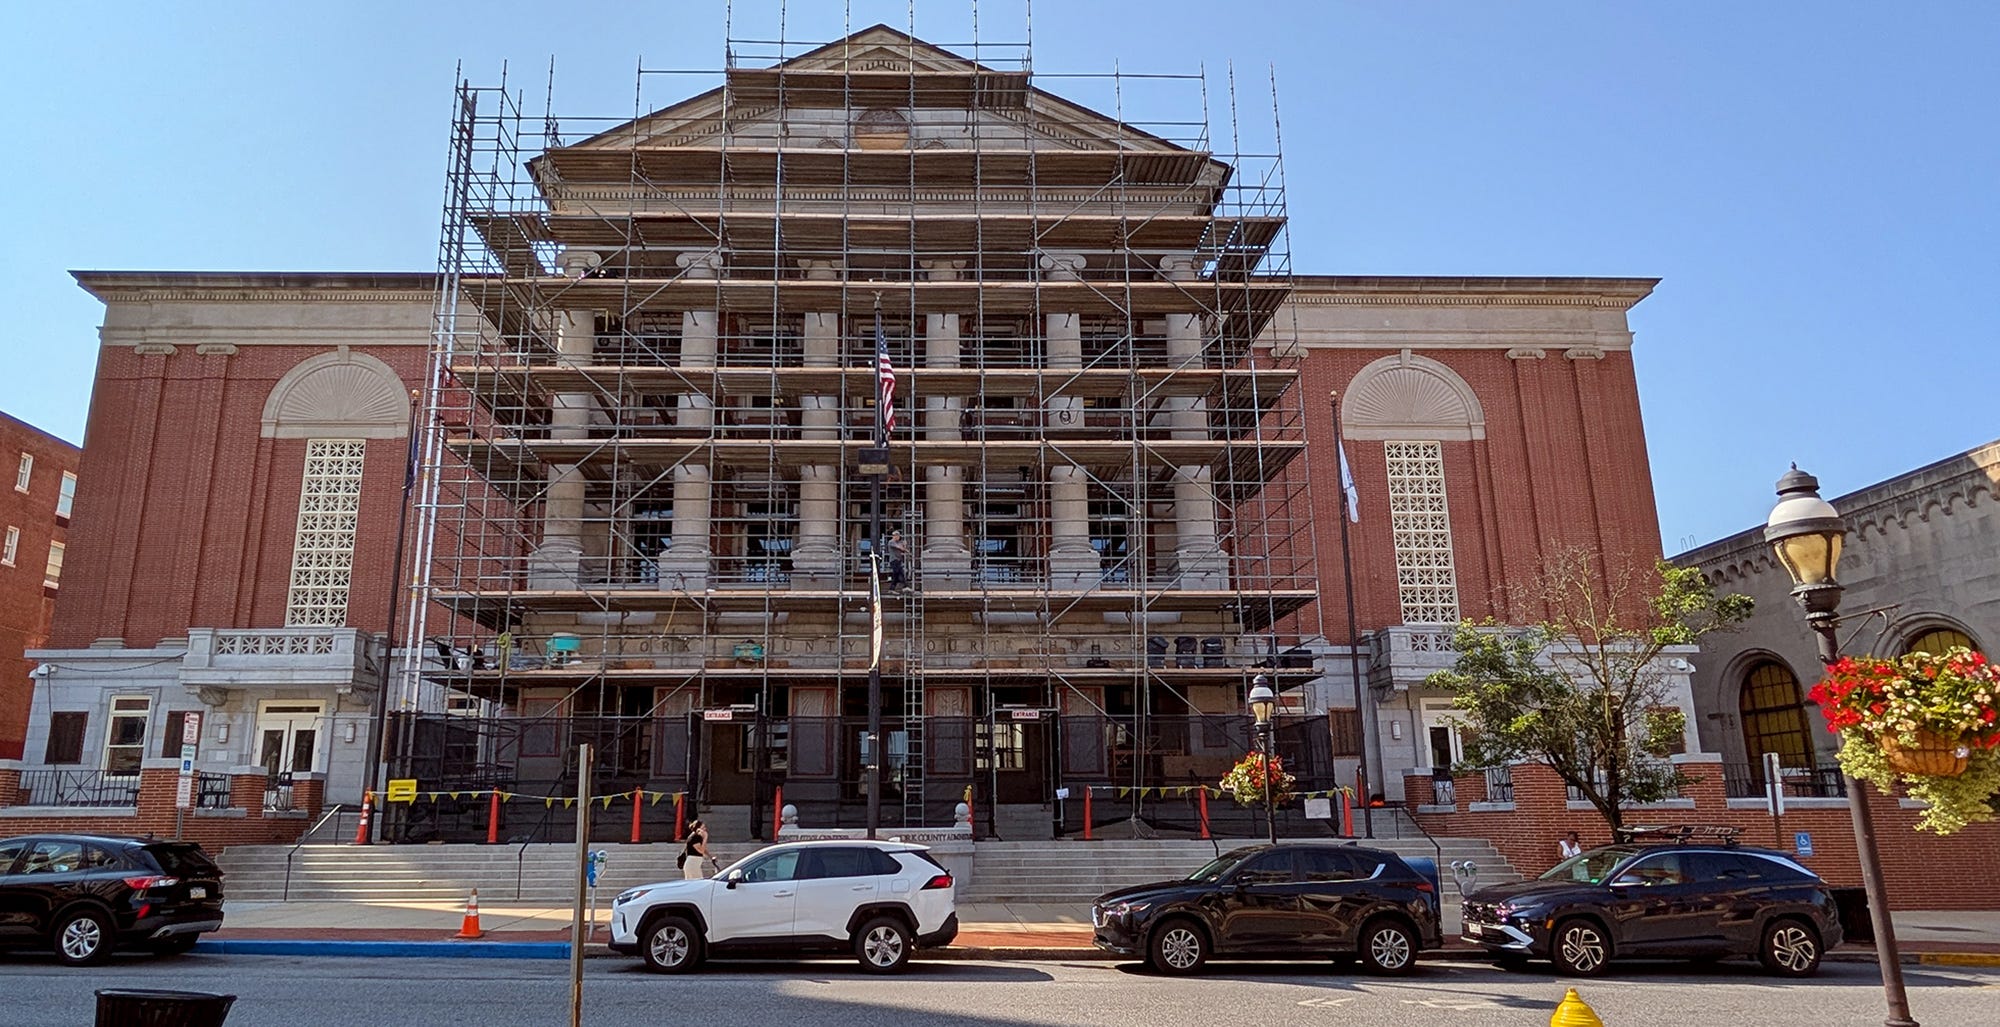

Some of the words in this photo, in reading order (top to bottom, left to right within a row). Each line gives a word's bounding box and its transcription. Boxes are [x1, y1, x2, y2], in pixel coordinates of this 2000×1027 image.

[619, 640, 690, 652] YORK
[764, 640, 856, 653] UNTY
[927, 640, 1000, 652] OURT
[917, 833, 947, 842] COUNTY
